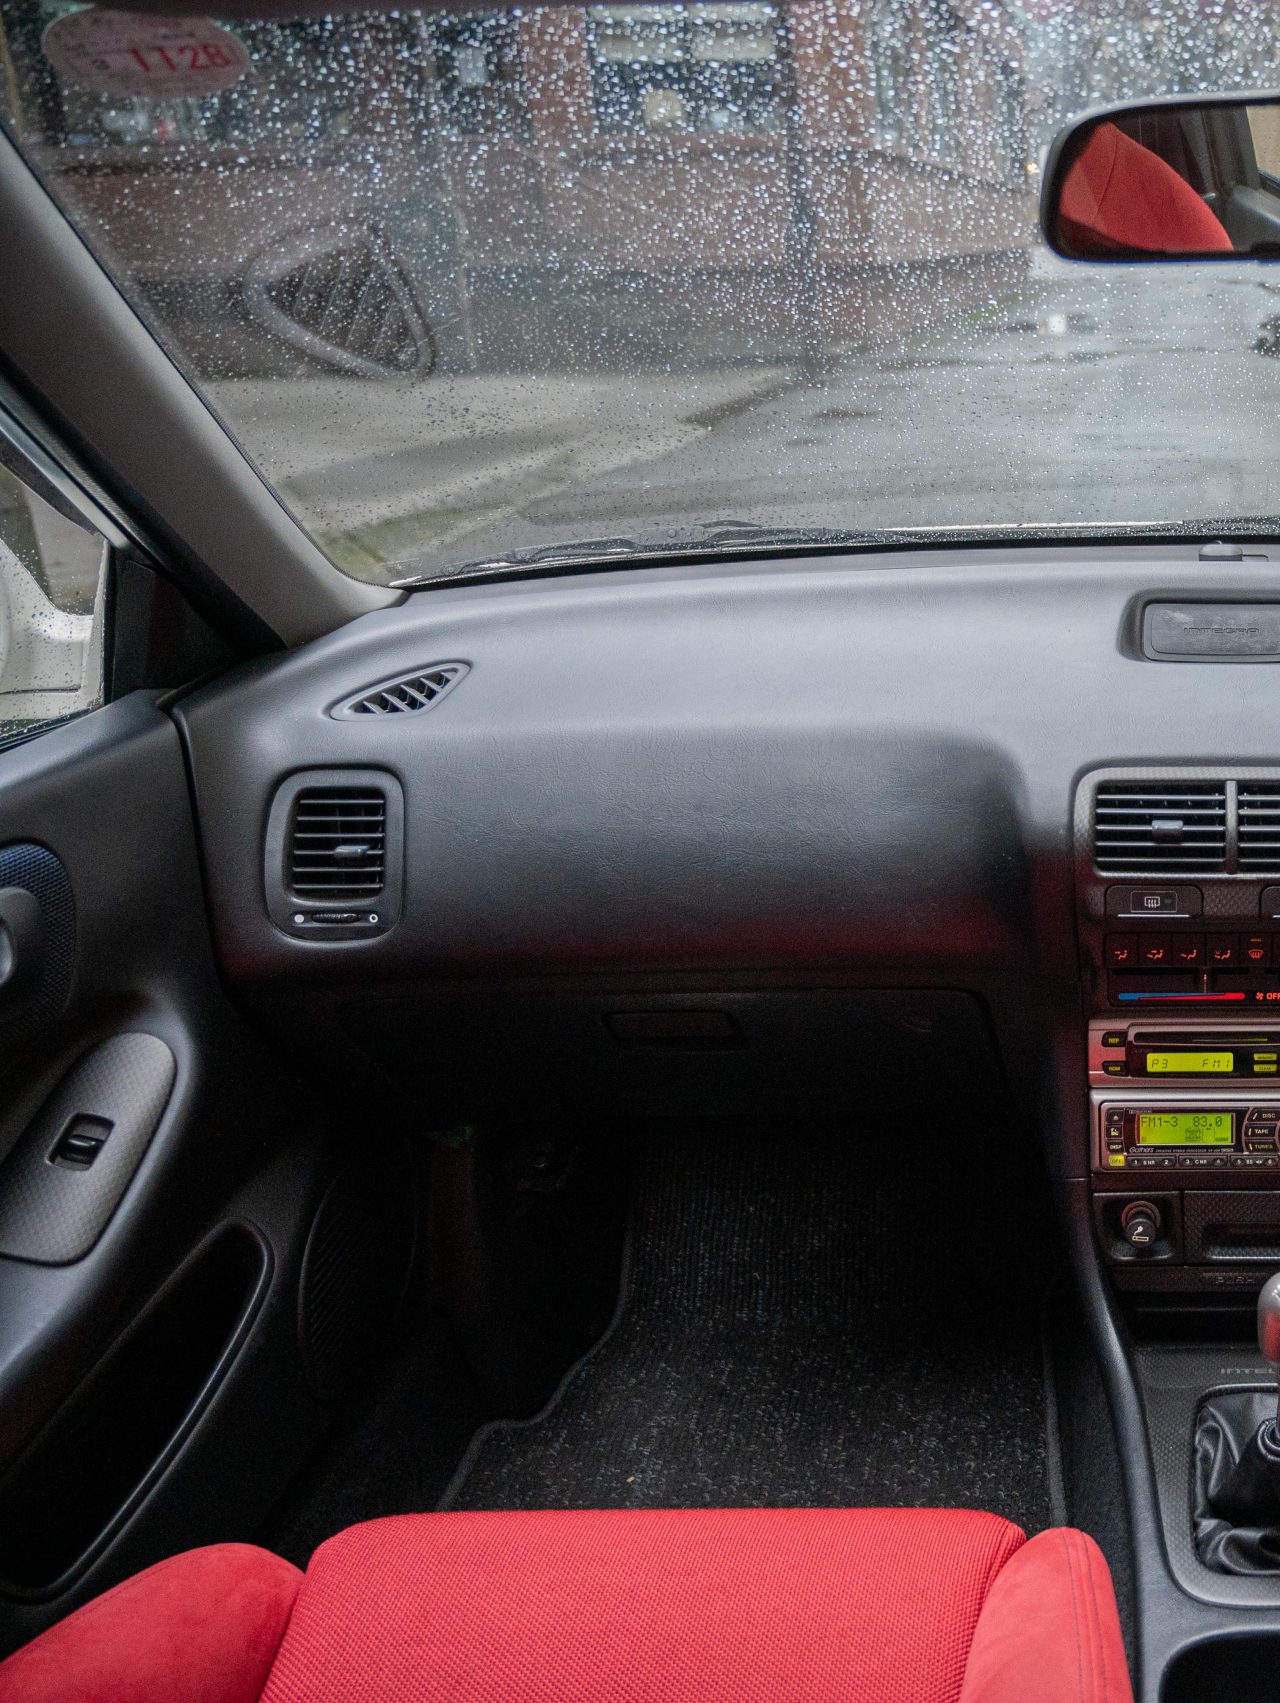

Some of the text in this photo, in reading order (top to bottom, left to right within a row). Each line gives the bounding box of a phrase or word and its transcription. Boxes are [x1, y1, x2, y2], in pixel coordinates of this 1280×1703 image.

[1151, 1058, 1168, 1069] P3
[1141, 1116, 1223, 1127] FM1-3 83.0
